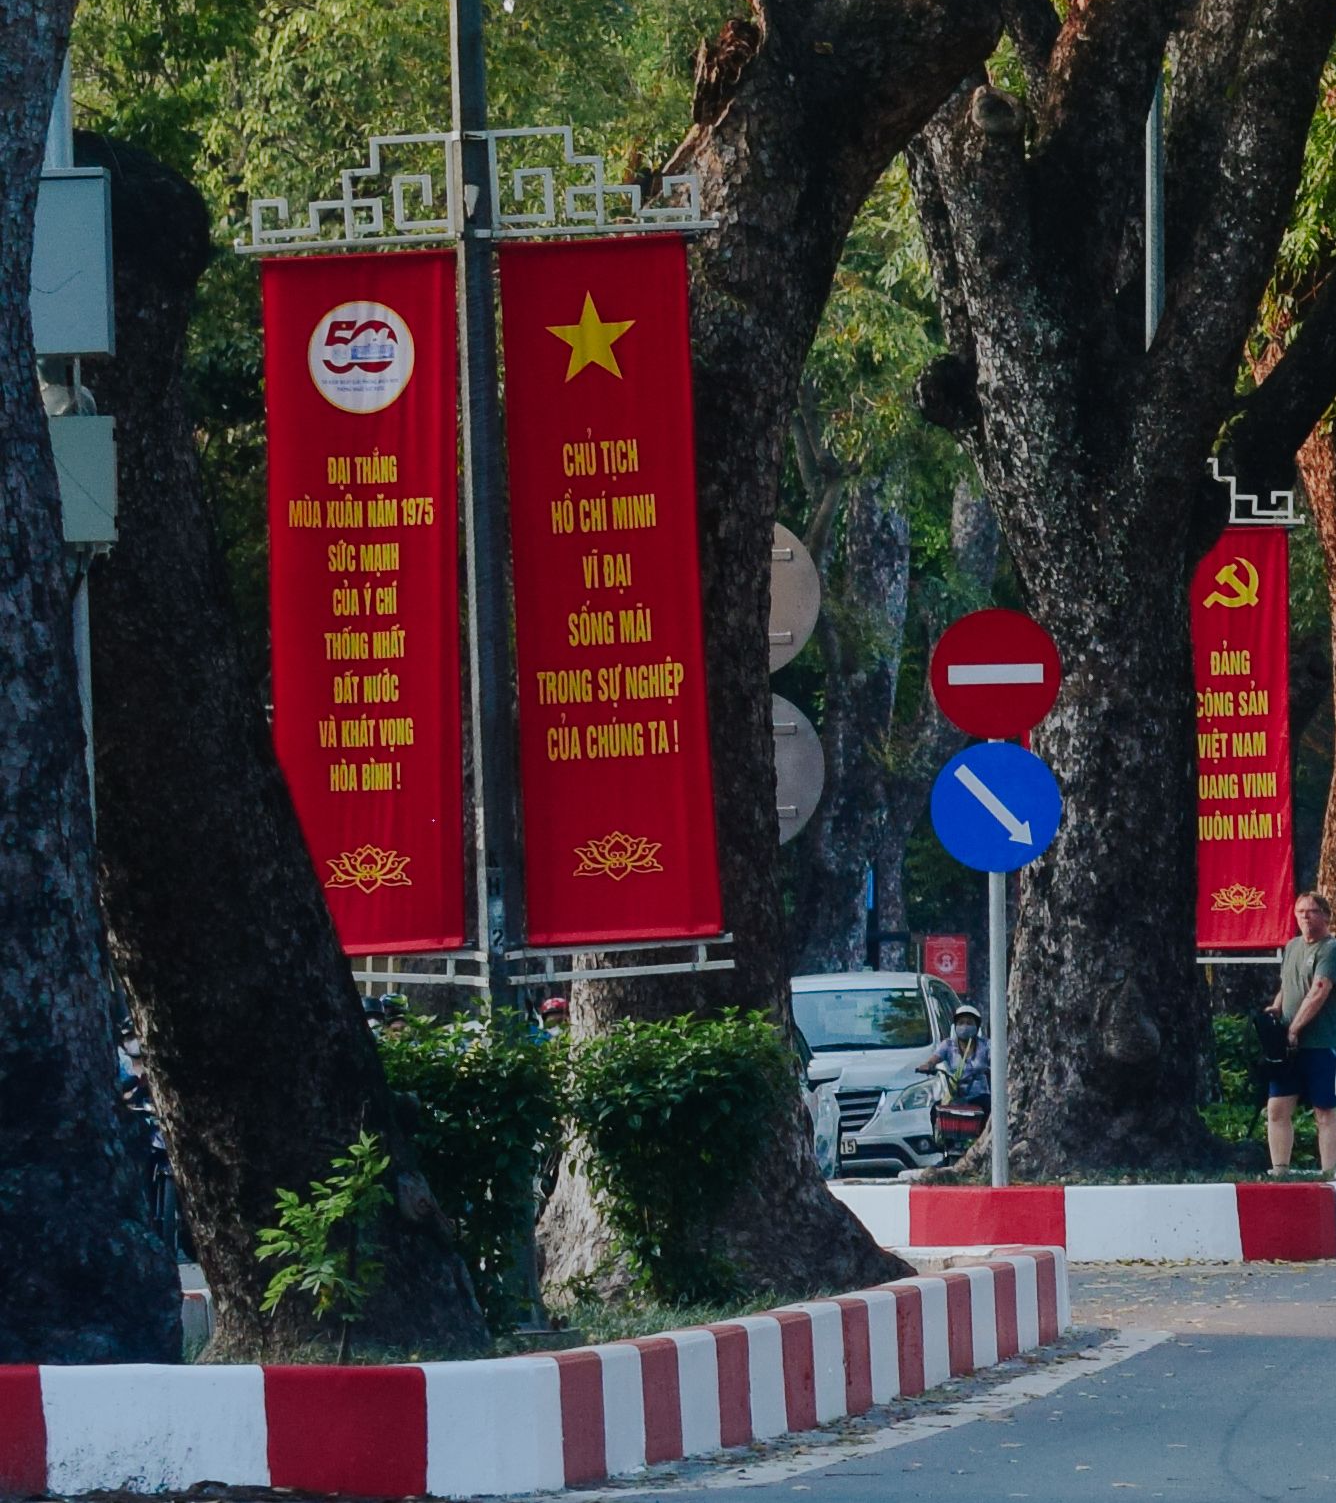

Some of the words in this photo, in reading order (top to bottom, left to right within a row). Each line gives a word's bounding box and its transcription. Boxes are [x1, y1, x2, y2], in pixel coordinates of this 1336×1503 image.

[327, 457, 351, 490] ĐẠI
[355, 447, 398, 484] THẮNG
[562, 427, 597, 477] CHỦ
[600, 439, 639, 481] TỊCH
[288, 494, 322, 528] MÙA
[326, 493, 363, 528] XUÂN
[367, 493, 398, 527] NĂM
[401, 497, 434, 526] 1975
[551, 488, 574, 534] HỒ
[579, 490, 607, 532] CHÍ
[611, 493, 657, 530] MINH
[328, 539, 356, 572] SỨC
[360, 543, 399, 577] MẠNH
[582, 549, 599, 589] VĨ
[603, 553, 632, 594] ĐẠI
[332, 579, 360, 616] CỦA
[363, 582, 372, 616] Ý
[376, 580, 397, 615] CHÍ
[324, 626, 369, 660] THỐNG
[373, 624, 405, 659] NHẤT
[568, 600, 614, 647] SỐNG
[619, 602, 652, 643] MÃI
[1210, 640, 1251, 676] ĐẢNG
[333, 670, 359, 704] ĐẤT
[363, 667, 399, 703] NƯỚC
[536, 669, 593, 705] TRONG
[598, 663, 622, 708] SỰ
[625, 655, 684, 704] NGHIỆP
[1238, 680, 1269, 717] SẢN
[319, 714, 337, 748] VÀ
[341, 713, 375, 748] KHÁT
[379, 717, 414, 752] VỌNG
[547, 712, 582, 761] CỦA
[586, 716, 644, 759] CHÚNG
[648, 720, 670, 755] TA
[1198, 727, 1228, 764] VIỆT
[1232, 731, 1267, 758] NAM
[330, 757, 357, 792] HÒA
[362, 757, 393, 791] BÌNH
[1198, 773, 1238, 800] UANG
[1242, 772, 1277, 798] VINH
[1198, 810, 1234, 841] UÔN
[1238, 809, 1272, 840] NĂM
